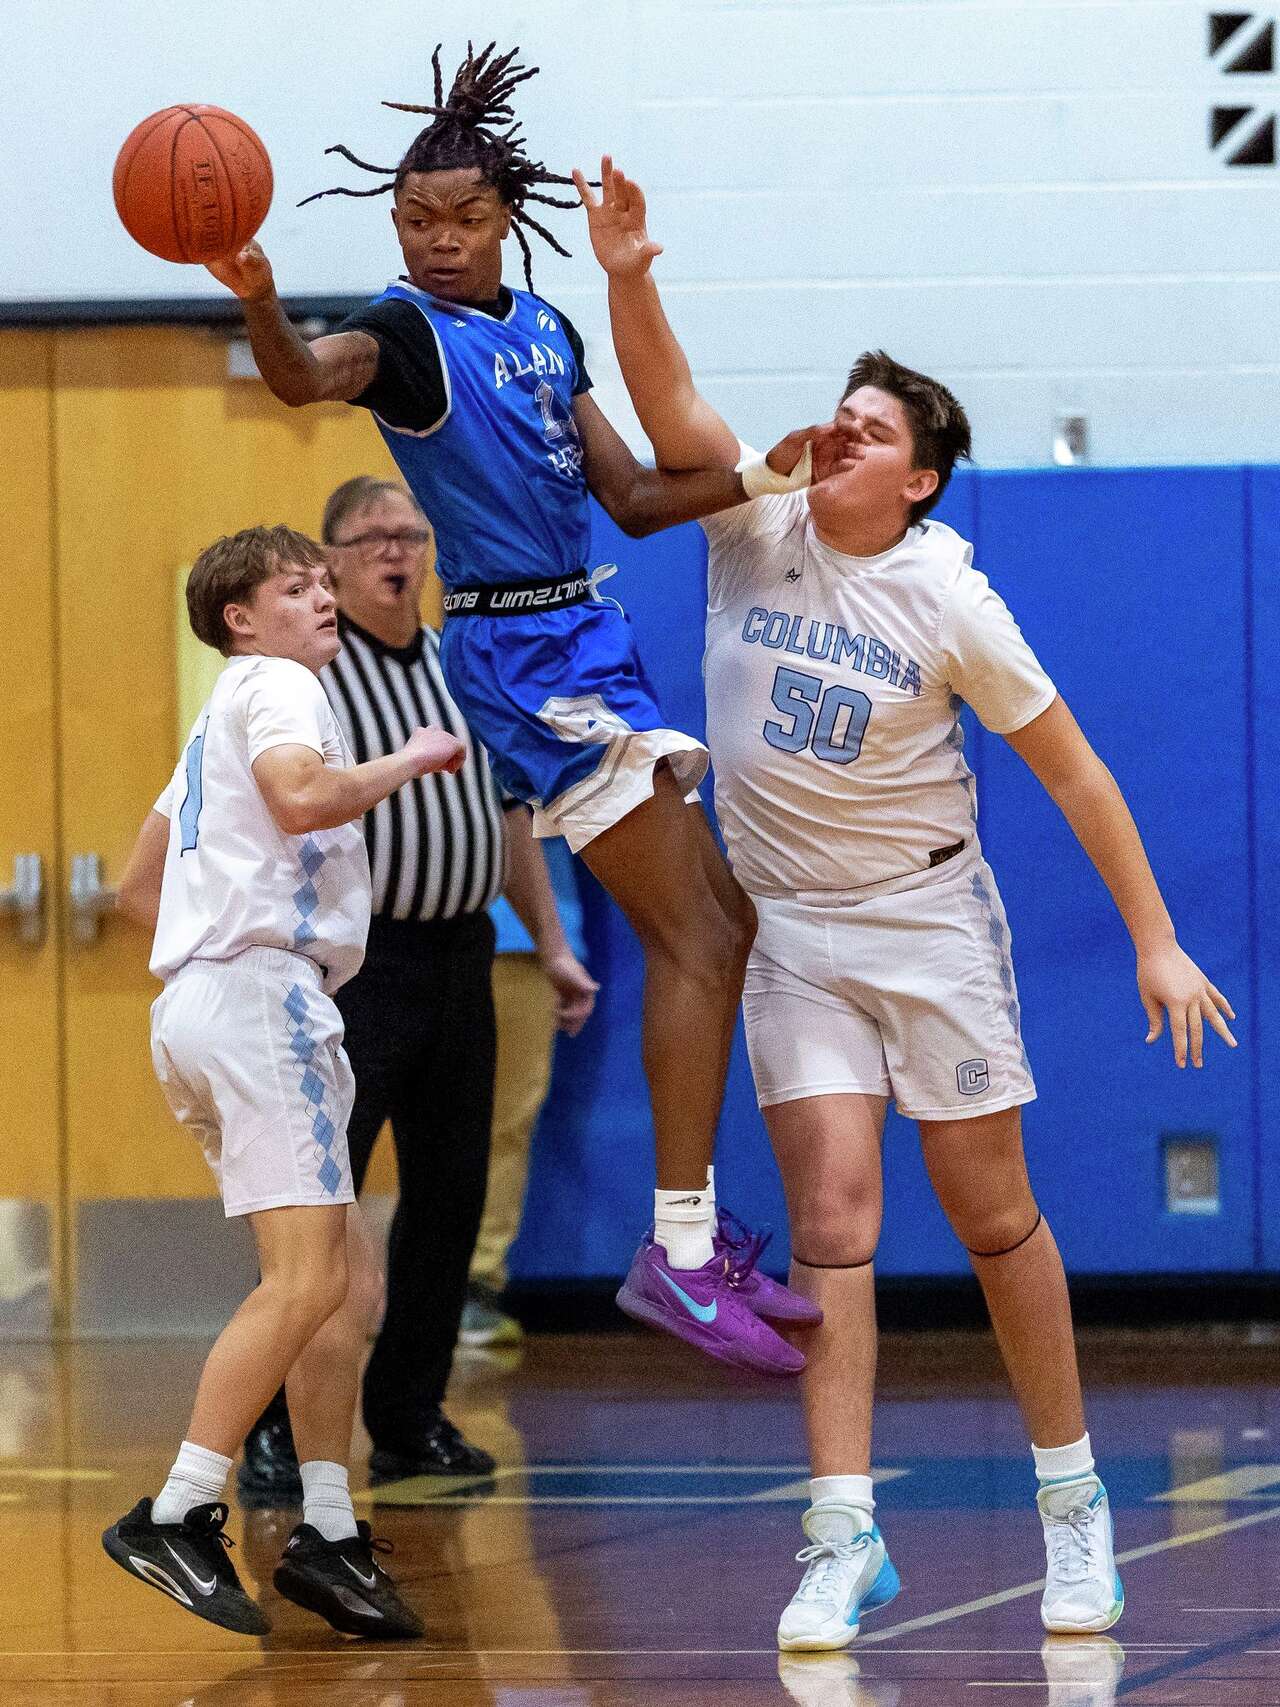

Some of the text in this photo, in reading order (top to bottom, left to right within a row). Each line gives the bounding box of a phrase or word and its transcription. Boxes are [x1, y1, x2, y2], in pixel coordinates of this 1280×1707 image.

[741, 607, 922, 696] COLUMBIA
[762, 666, 873, 765] 50
[956, 1058, 990, 1096] C
